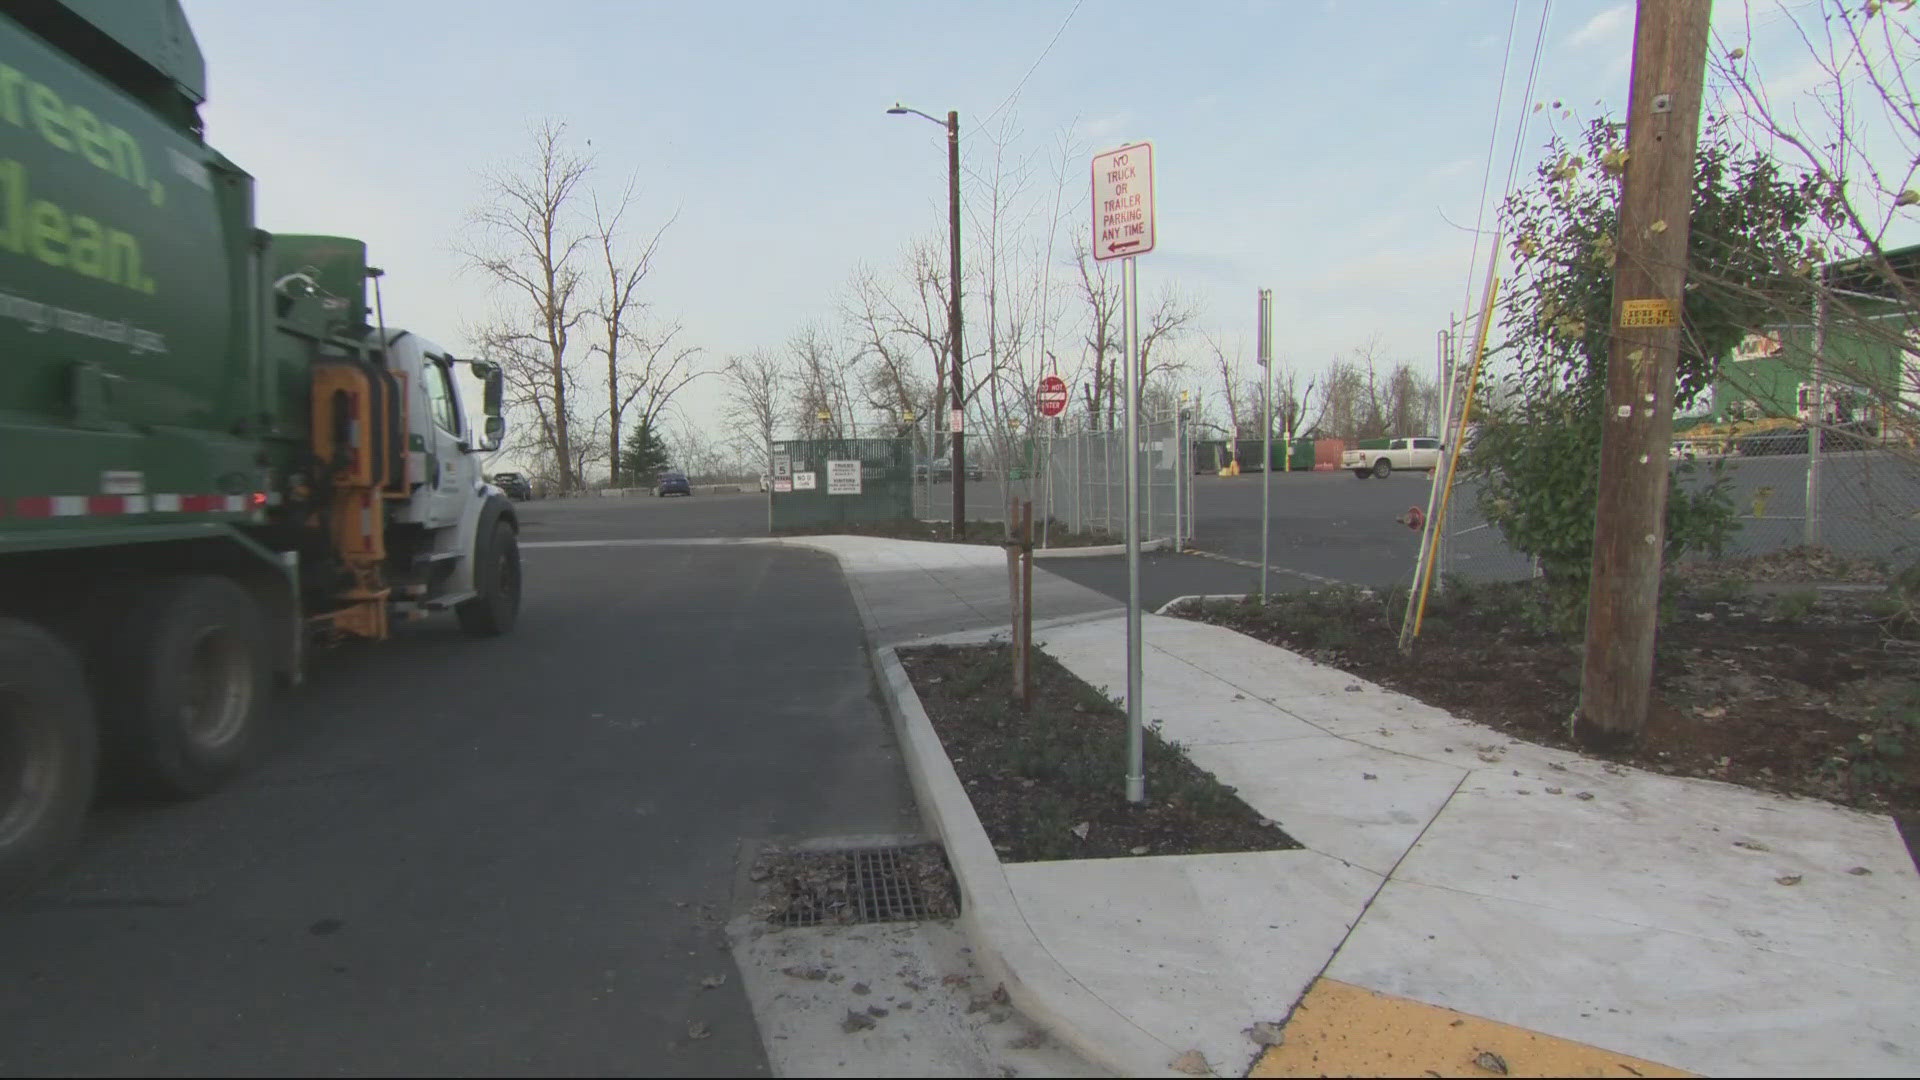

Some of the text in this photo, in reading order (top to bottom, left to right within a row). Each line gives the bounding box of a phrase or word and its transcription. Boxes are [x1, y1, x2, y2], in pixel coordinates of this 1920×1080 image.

[0, 62, 165, 207] reen,
[1113, 154, 1128, 168] NO
[1107, 167, 1136, 184] TRUCK
[1115, 183, 1128, 196] OR
[1104, 194, 1141, 213] TRAILER
[0, 157, 155, 295] lean.
[1103, 209, 1142, 227] PARKING
[1102, 222, 1144, 242] ANY TIME
[1051, 383, 1063, 391] NOT
[779, 466, 786, 475] 5
